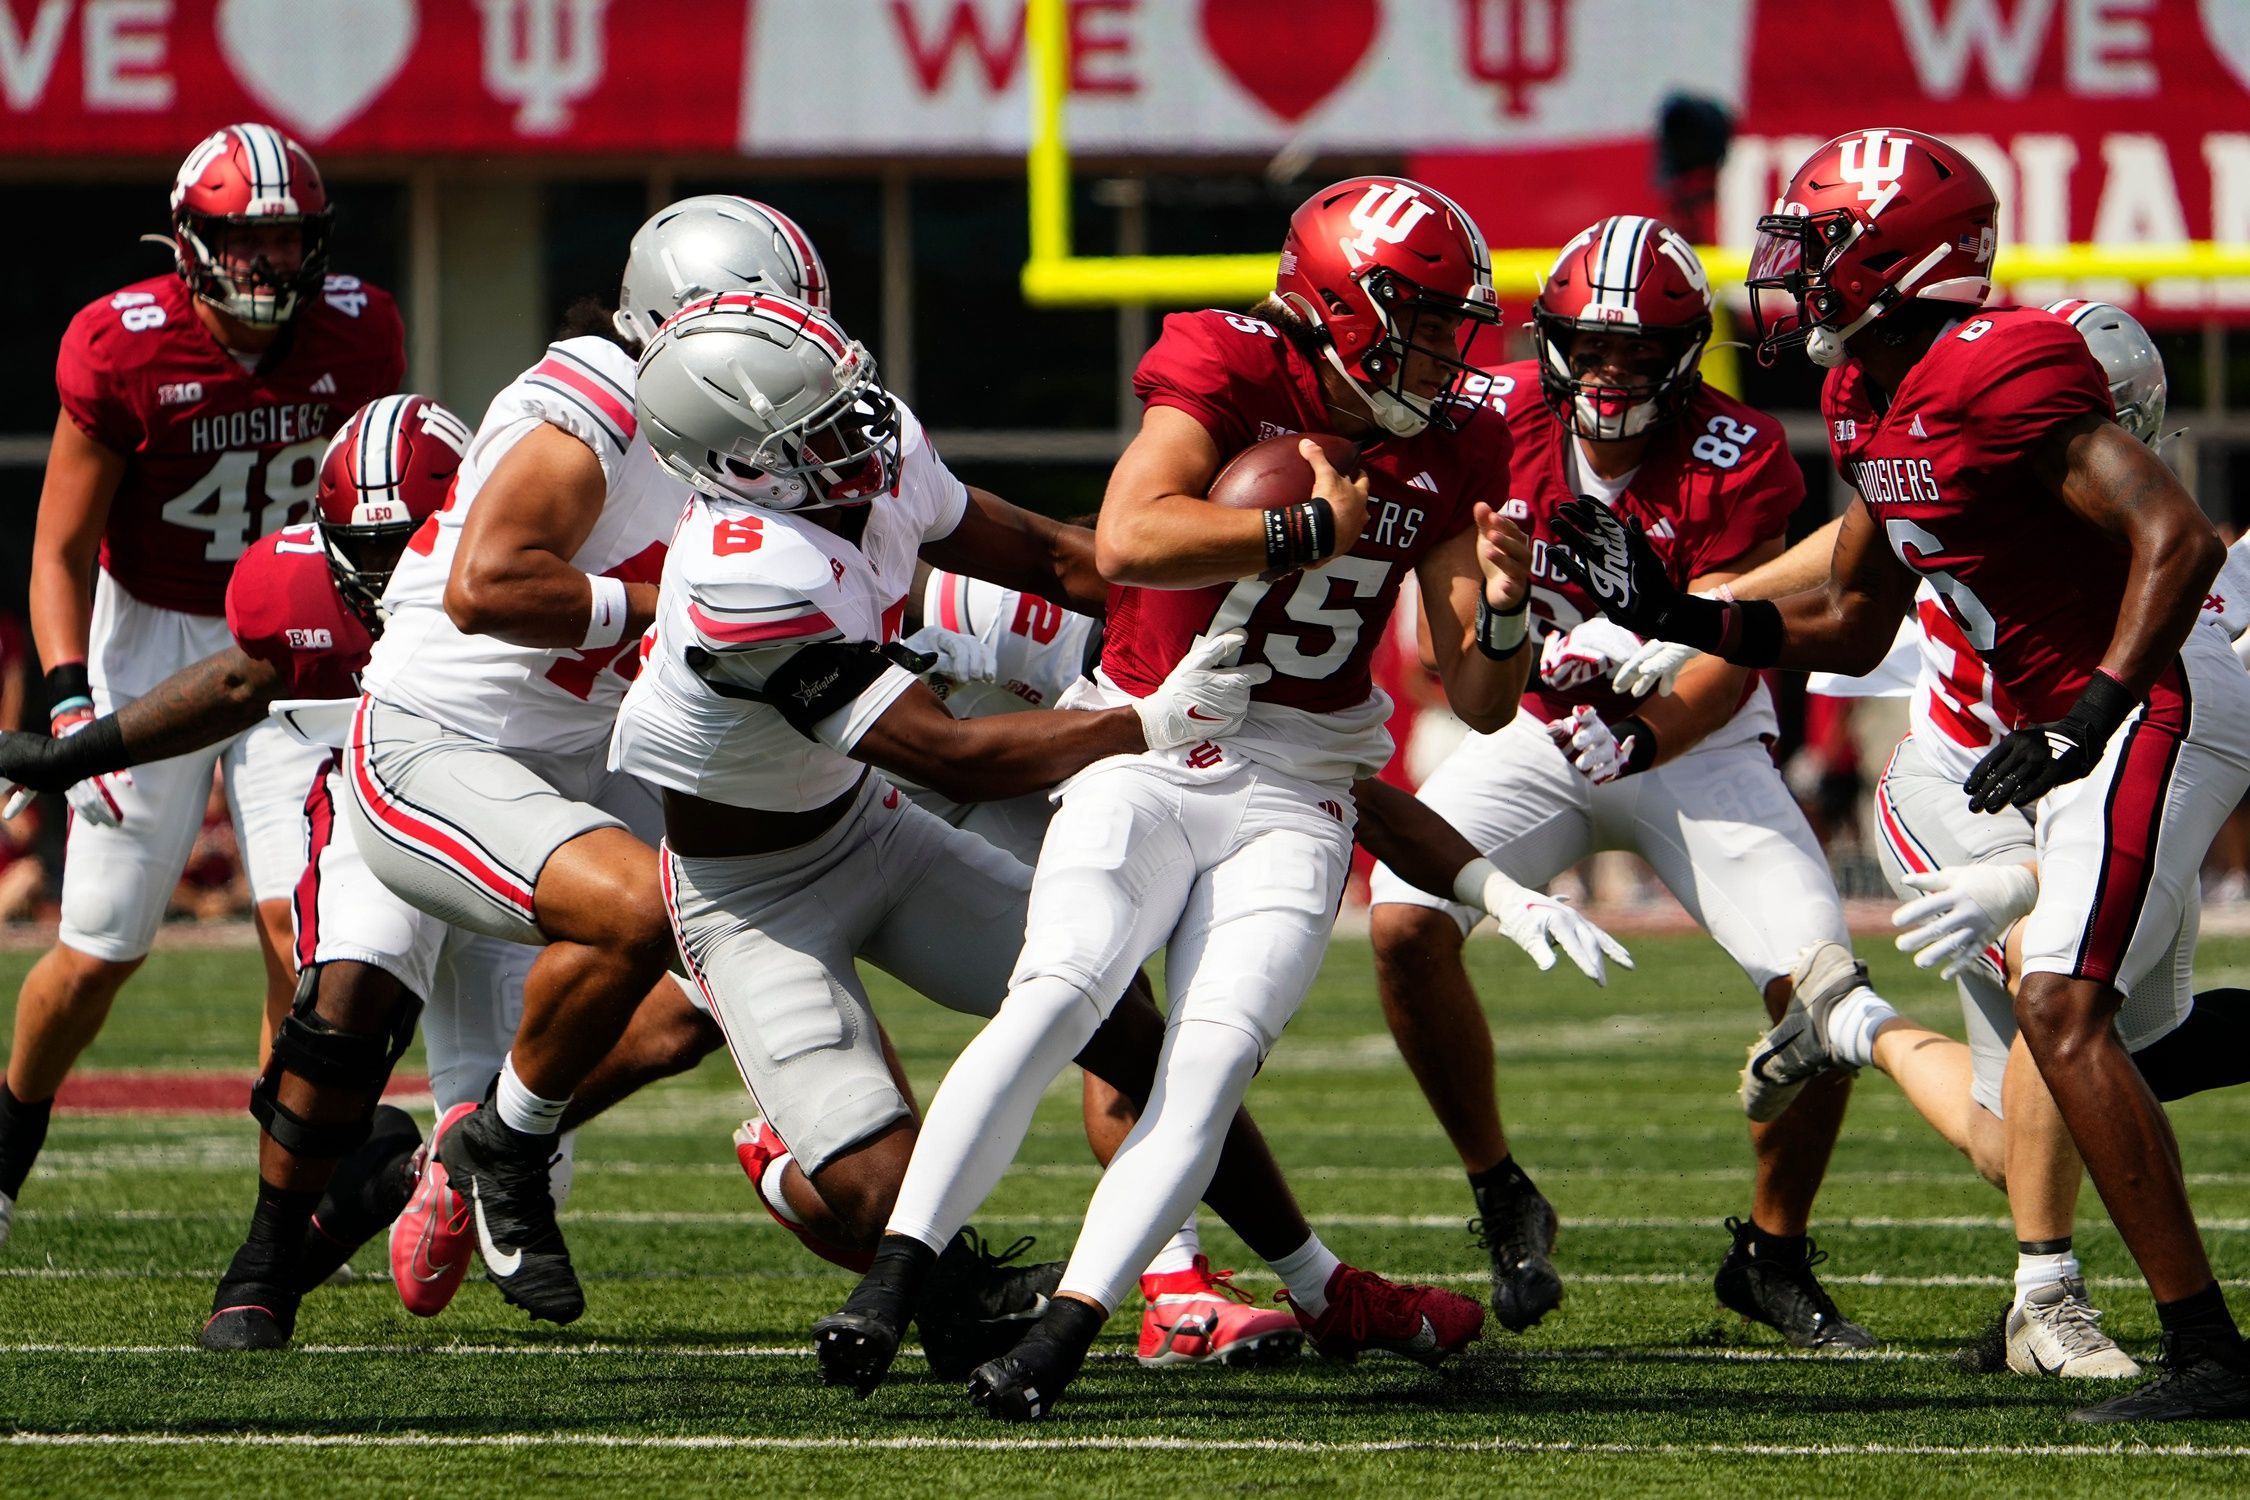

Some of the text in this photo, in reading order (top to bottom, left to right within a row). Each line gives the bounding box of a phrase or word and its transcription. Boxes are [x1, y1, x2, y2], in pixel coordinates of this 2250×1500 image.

[1893, 0, 2161, 99] WE
[1956, 319, 1993, 341] 6
[192, 402, 328, 453] HOOSIERS
[1692, 415, 1758, 468] 82
[1850, 459, 1940, 503] HOOSIERS
[366, 507, 392, 522] LEO
[713, 516, 763, 557] 6
[1886, 518, 1997, 650] 6
[802, 670, 840, 699] Douglas
